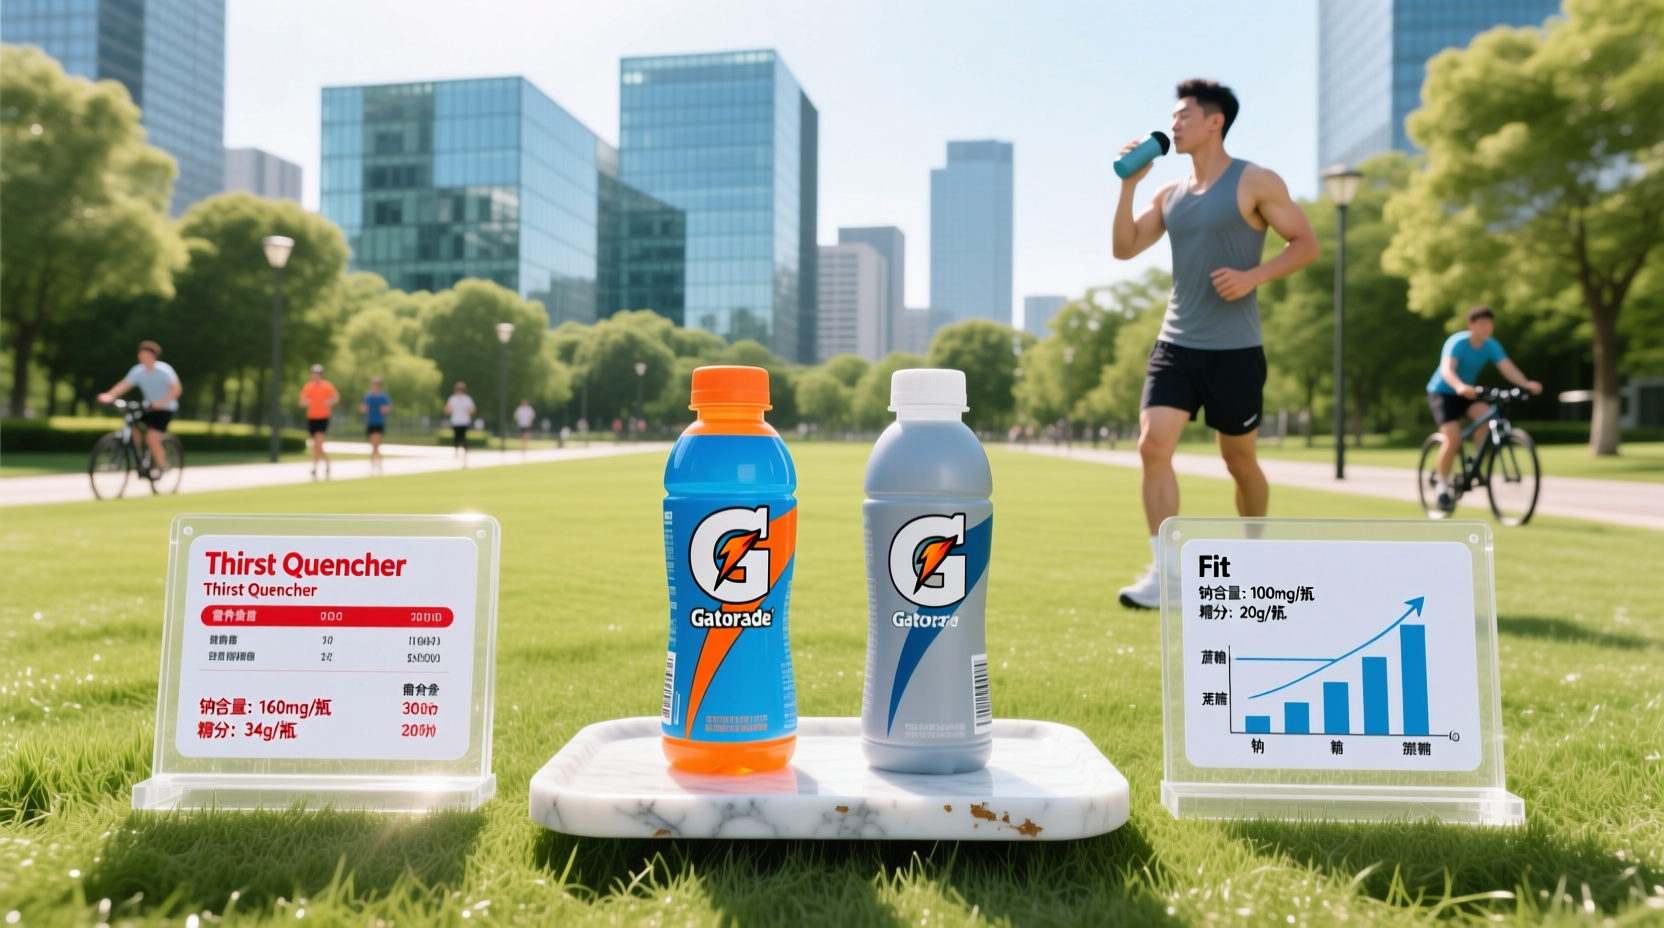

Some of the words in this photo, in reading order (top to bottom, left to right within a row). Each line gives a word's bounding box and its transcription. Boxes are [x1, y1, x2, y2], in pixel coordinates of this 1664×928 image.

[205, 551, 277, 576] Thirst
[282, 551, 407, 579] Quencher
[689, 505, 771, 604] G
[888, 512, 967, 609] G
[1198, 554, 1231, 578] Fit
[203, 582, 245, 597] Thirst
[248, 582, 318, 599] Quencher
[690, 607, 773, 628] Gatorade
